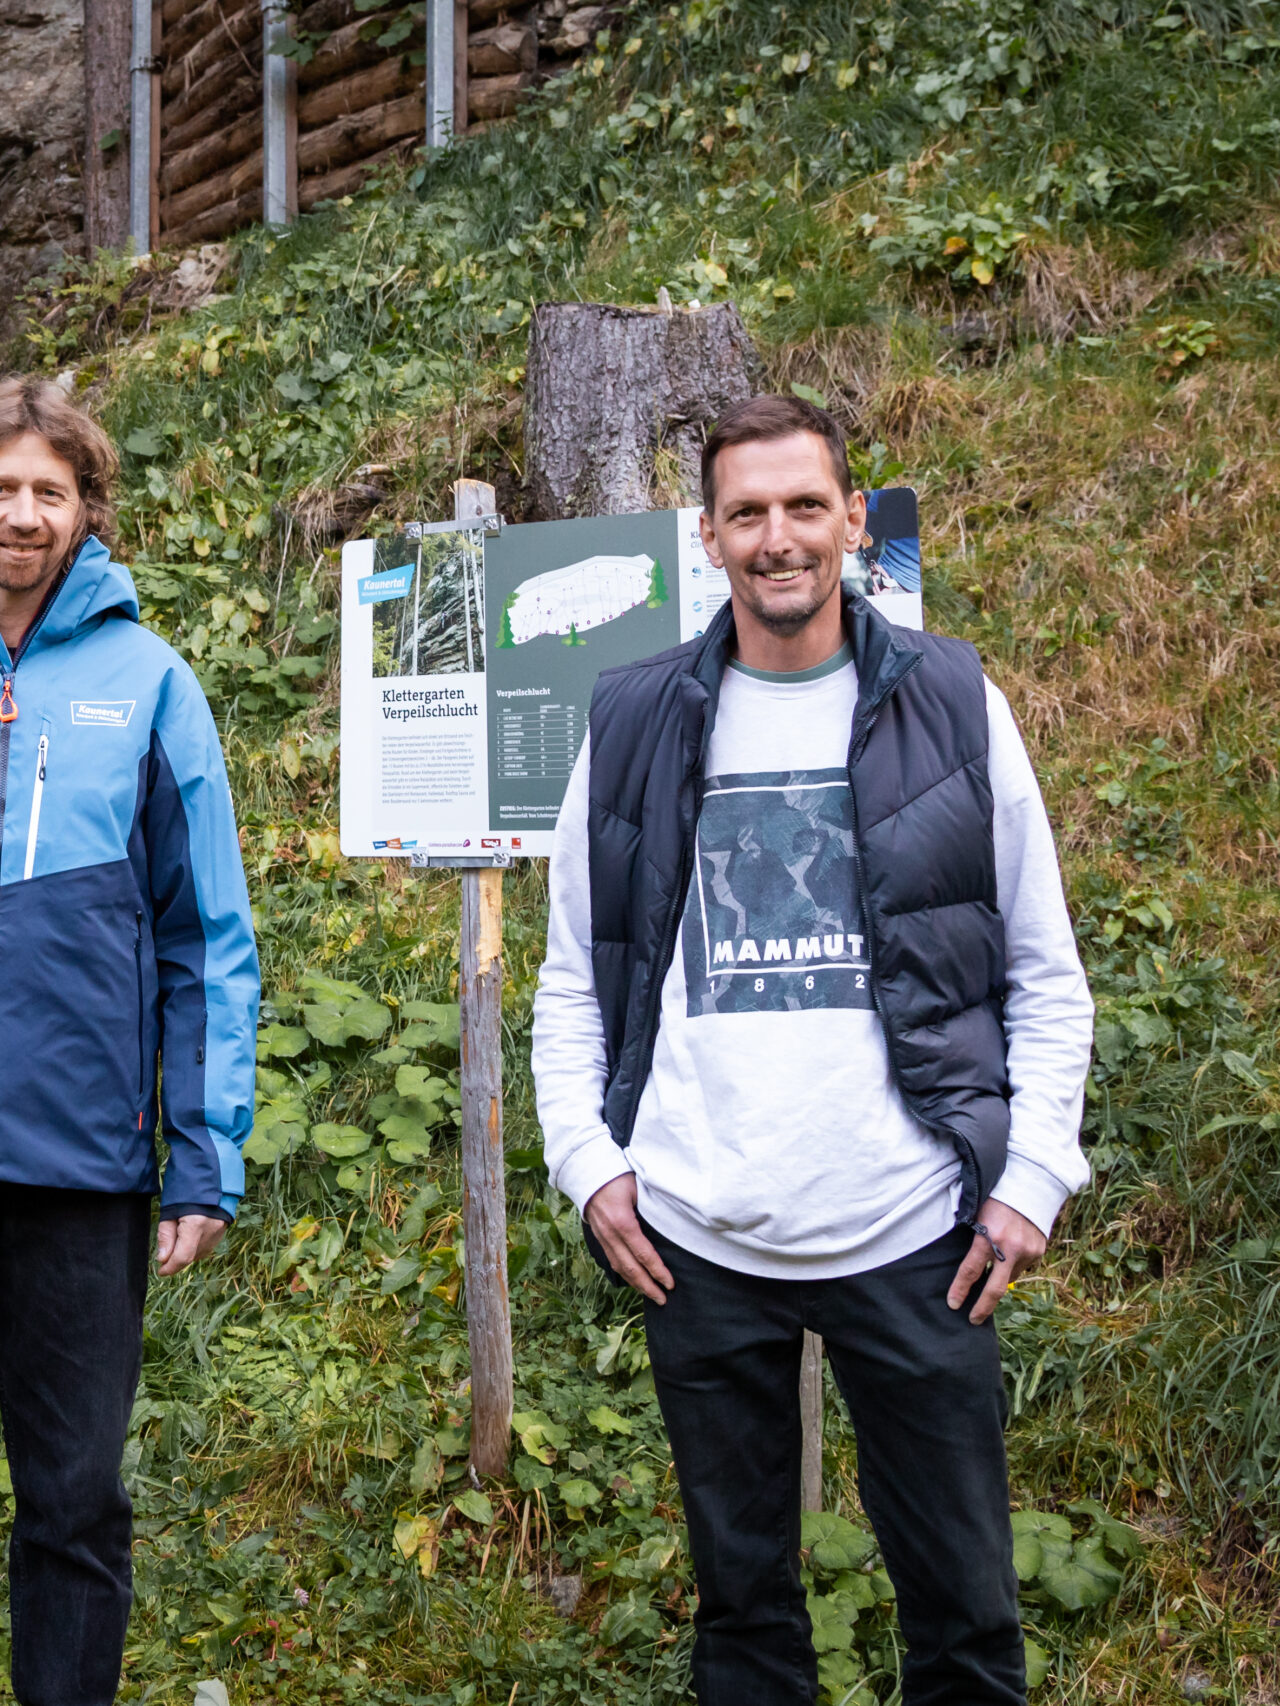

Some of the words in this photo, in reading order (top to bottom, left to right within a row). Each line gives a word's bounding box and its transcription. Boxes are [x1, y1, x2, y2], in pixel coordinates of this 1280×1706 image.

[363, 576, 406, 591] Kaunertal
[382, 688, 465, 704] Klettergarten
[496, 687, 551, 698] Verpeilschlucht
[78, 704, 124, 719] Kaunertal
[382, 703, 479, 722] Verpeilschlucht
[713, 934, 864, 964] MAMMUT
